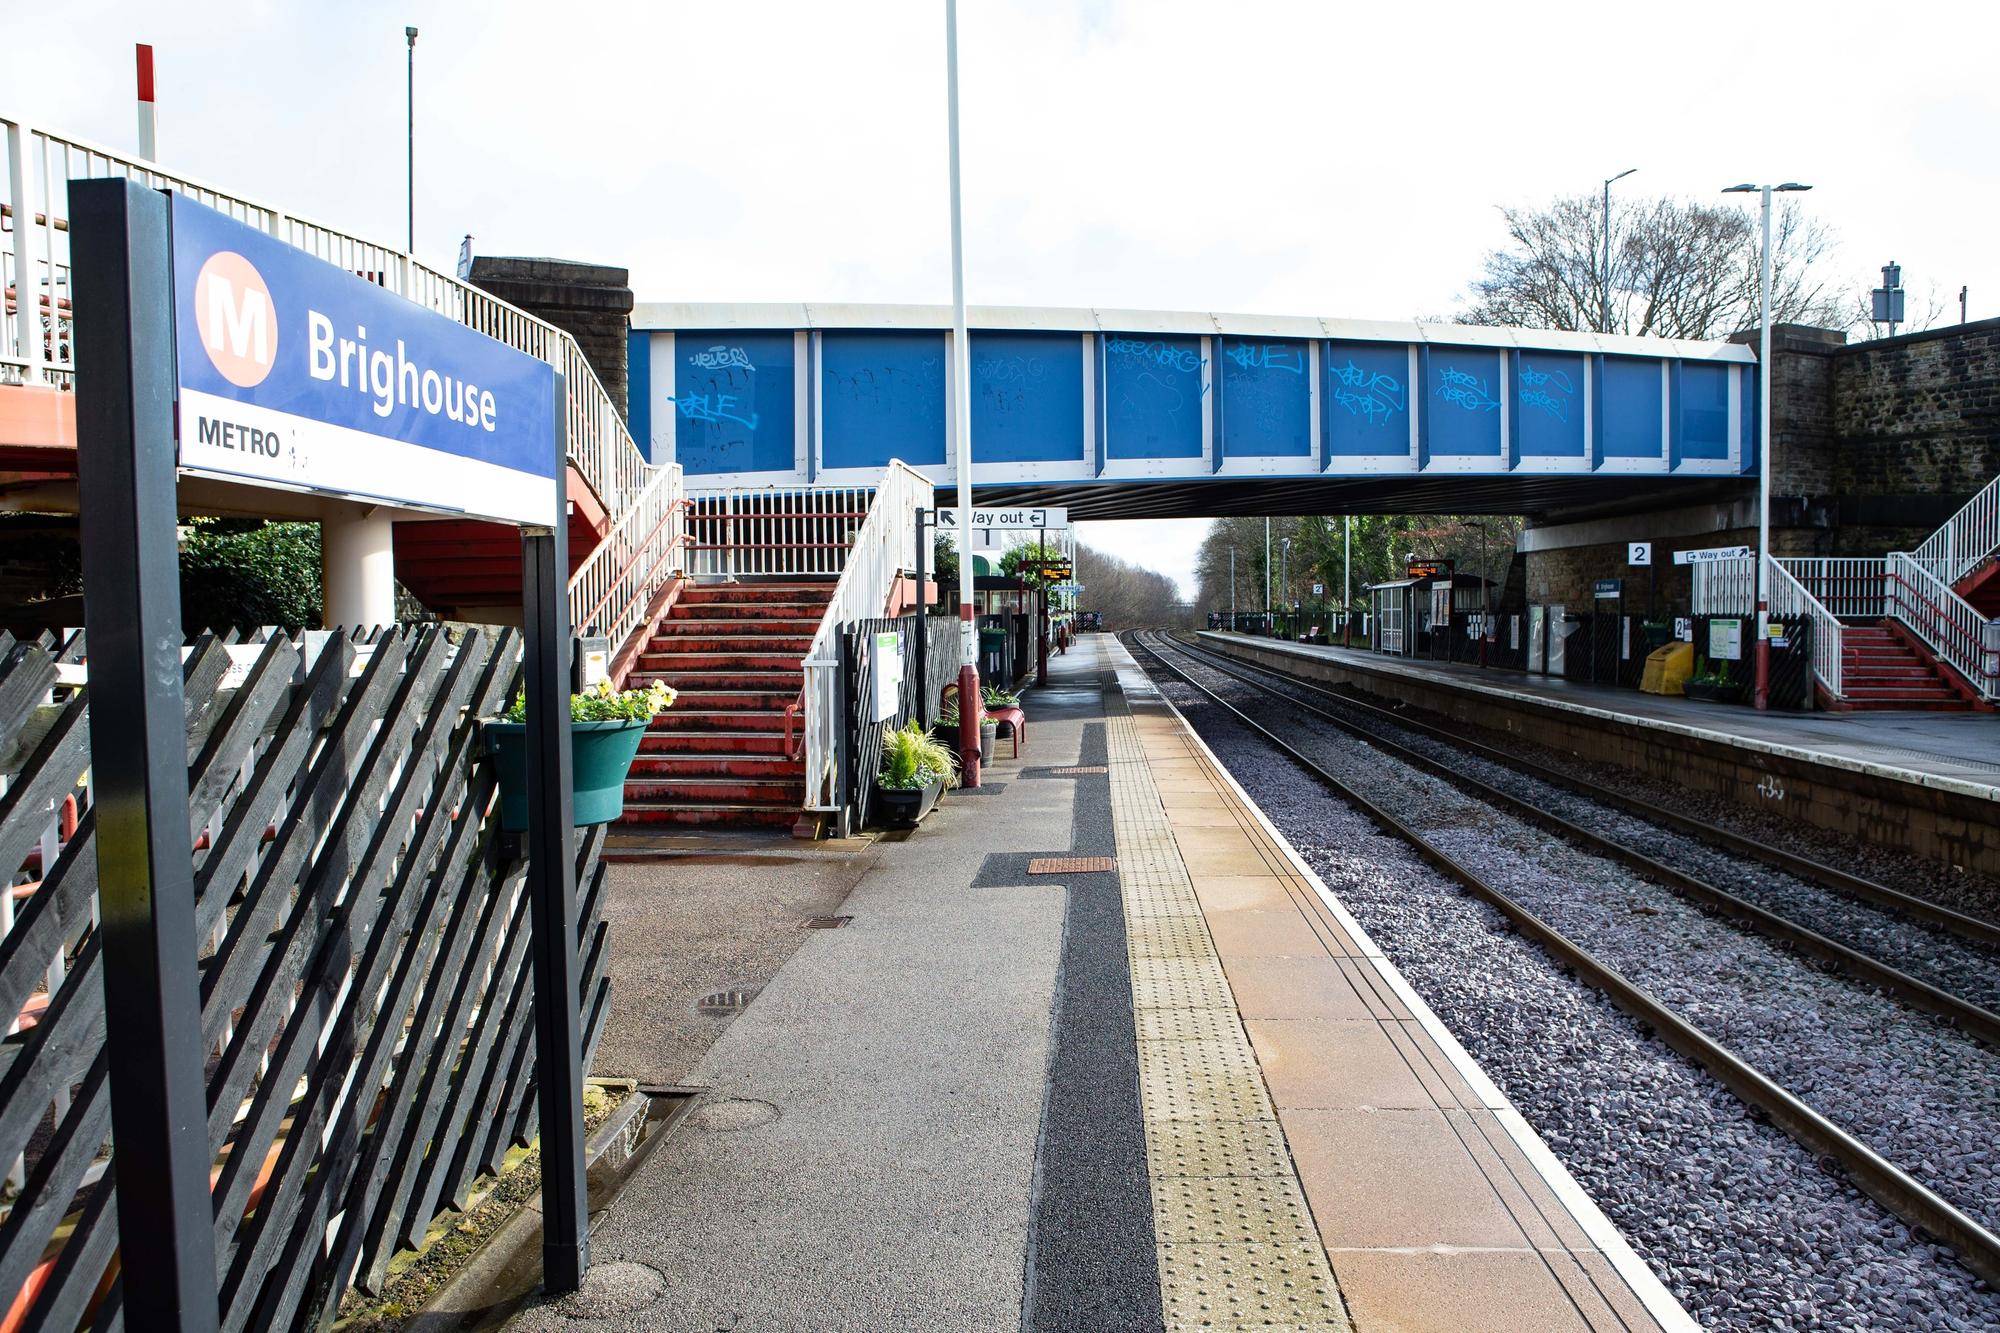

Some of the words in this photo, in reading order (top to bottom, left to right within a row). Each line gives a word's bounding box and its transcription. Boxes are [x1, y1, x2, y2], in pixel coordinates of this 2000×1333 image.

[207, 272, 268, 365] M
[307, 309, 497, 432] Brighouse
[198, 415, 280, 458] METRO
[972, 511, 995, 525] ay
[1000, 511, 1024, 524] out
[1634, 546, 1646, 561] 2
[1700, 551, 1718, 560] Way
[1721, 549, 1735, 558] out
[1315, 585, 1322, 593] 2
[1676, 620, 1683, 636] 2
